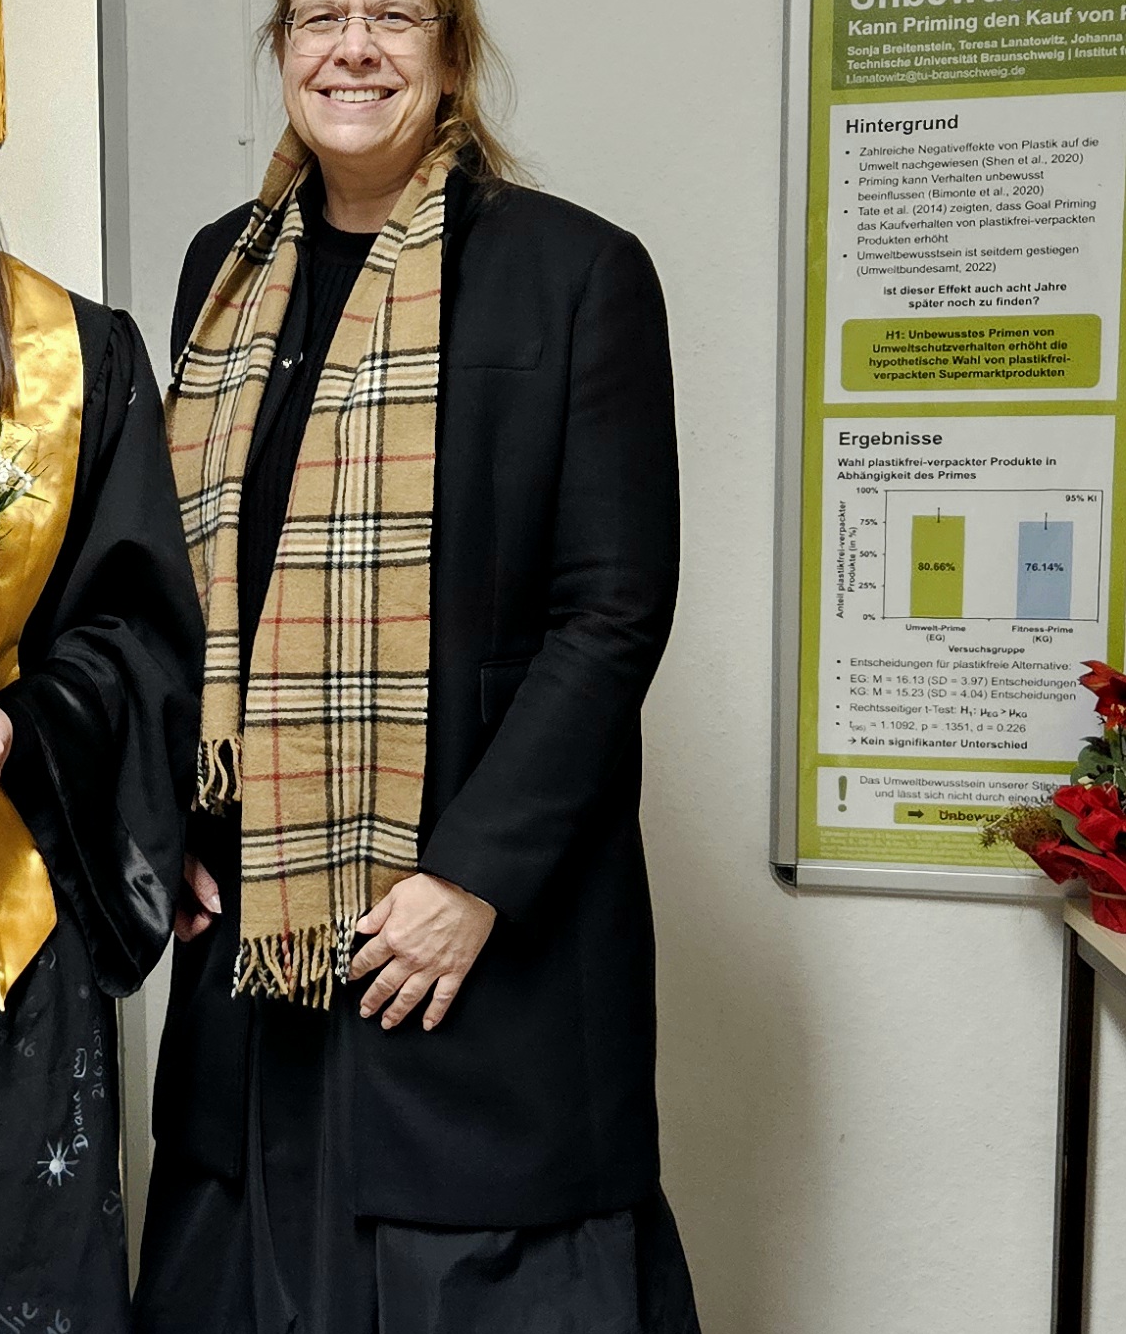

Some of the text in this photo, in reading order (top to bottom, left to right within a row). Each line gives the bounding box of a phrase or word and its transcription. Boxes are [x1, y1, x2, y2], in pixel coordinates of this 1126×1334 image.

[848, 19, 897, 36] Kann
[902, 15, 978, 33] Priming
[984, 11, 1020, 27] den
[1026, 7, 1074, 25] Kauf
[1076, 9, 1114, 23] von
[847, 33, 1123, 57] Sonja Breitenstein, Teresa Lanatowitz, Johanna
[846, 57, 911, 69] Technische
[914, 53, 978, 67] Universität
[980, 49, 1065, 63] Braunschweig
[1074, 46, 1117, 57] Institut
[846, 114, 958, 135] Hintergrund
[859, 137, 1100, 157] Zahlreiche Negativeffekte von Plastik auf die
[859, 153, 1084, 171] Umwelt nachgewiesen (Shen 2020)
[858, 170, 1044, 187] Priming kann Verhalten unbewusst
[858, 191, 925, 201] beeinflussen
[1012, 185, 1044, 197] 2020)
[858, 199, 1096, 216] Tate et (2014) zeigten, dass Goal Priming
[857, 214, 1096, 231] das Kaufverhalten von plastikfrei-verpackten
[857, 233, 948, 245] Produkten erhöht
[857, 245, 1079, 260] Umweltbewusstsein ist seitdem gestiegen
[966, 262, 996, 273] 2022)
[884, 282, 1067, 295] Ist dieser Effekt auch acht Jahre
[908, 296, 1040, 310] später noch zu finden?
[886, 328, 1054, 339] H1: Unbewusstes Primen von
[872, 340, 1068, 353] Umweltschutzverhalten erhöht die
[869, 354, 1070, 368] hypothetische Wahl von plastikfrei-
[874, 367, 1065, 381] verpackten Supermarktprodukten
[839, 431, 943, 449] Ergebnisse
[838, 457, 1057, 468] Wahl plastikfrei-verpackter Produkte in
[837, 471, 976, 481] Abhängigkeit des Primes
[836, 501, 847, 619] Anteil plastikfrei-verpackter
[918, 562, 956, 571] 80.66%
[848, 553, 856, 593] Produkte
[1024, 563, 1064, 572] 76.14%
[905, 624, 966, 632] Umwelt-Prime
[1012, 625, 1074, 633] Fitness-Prime
[926, 633, 946, 643] (EG)
[1032, 635, 1052, 644] (KG)
[948, 645, 1026, 655] Versuchsgruppe
[850, 657, 933, 669] Entscheidungen
[936, 659, 950, 668] für
[952, 660, 1010, 670] plastikfreie
[850, 674, 1076, 689] EG: 16.13 (SD 3.97) Entscheidungen
[850, 687, 1076, 701] KG: 15.23 (SD 4.04) Entscheidungen
[849, 703, 922, 715] Rechtsseitiger
[996, 723, 1026, 733] 0.226
[860, 737, 1028, 749] Kein signifikanter Unterschied
[860, 775, 880, 785] Das
[884, 777, 985, 789] Umweltbewusstsein
[988, 781, 1028, 789] unserer
[875, 789, 894, 798] und
[897, 789, 921, 799] lässt
[924, 791, 944, 799] sich
[948, 791, 972, 801] nicht
[976, 791, 1005, 802] durch
